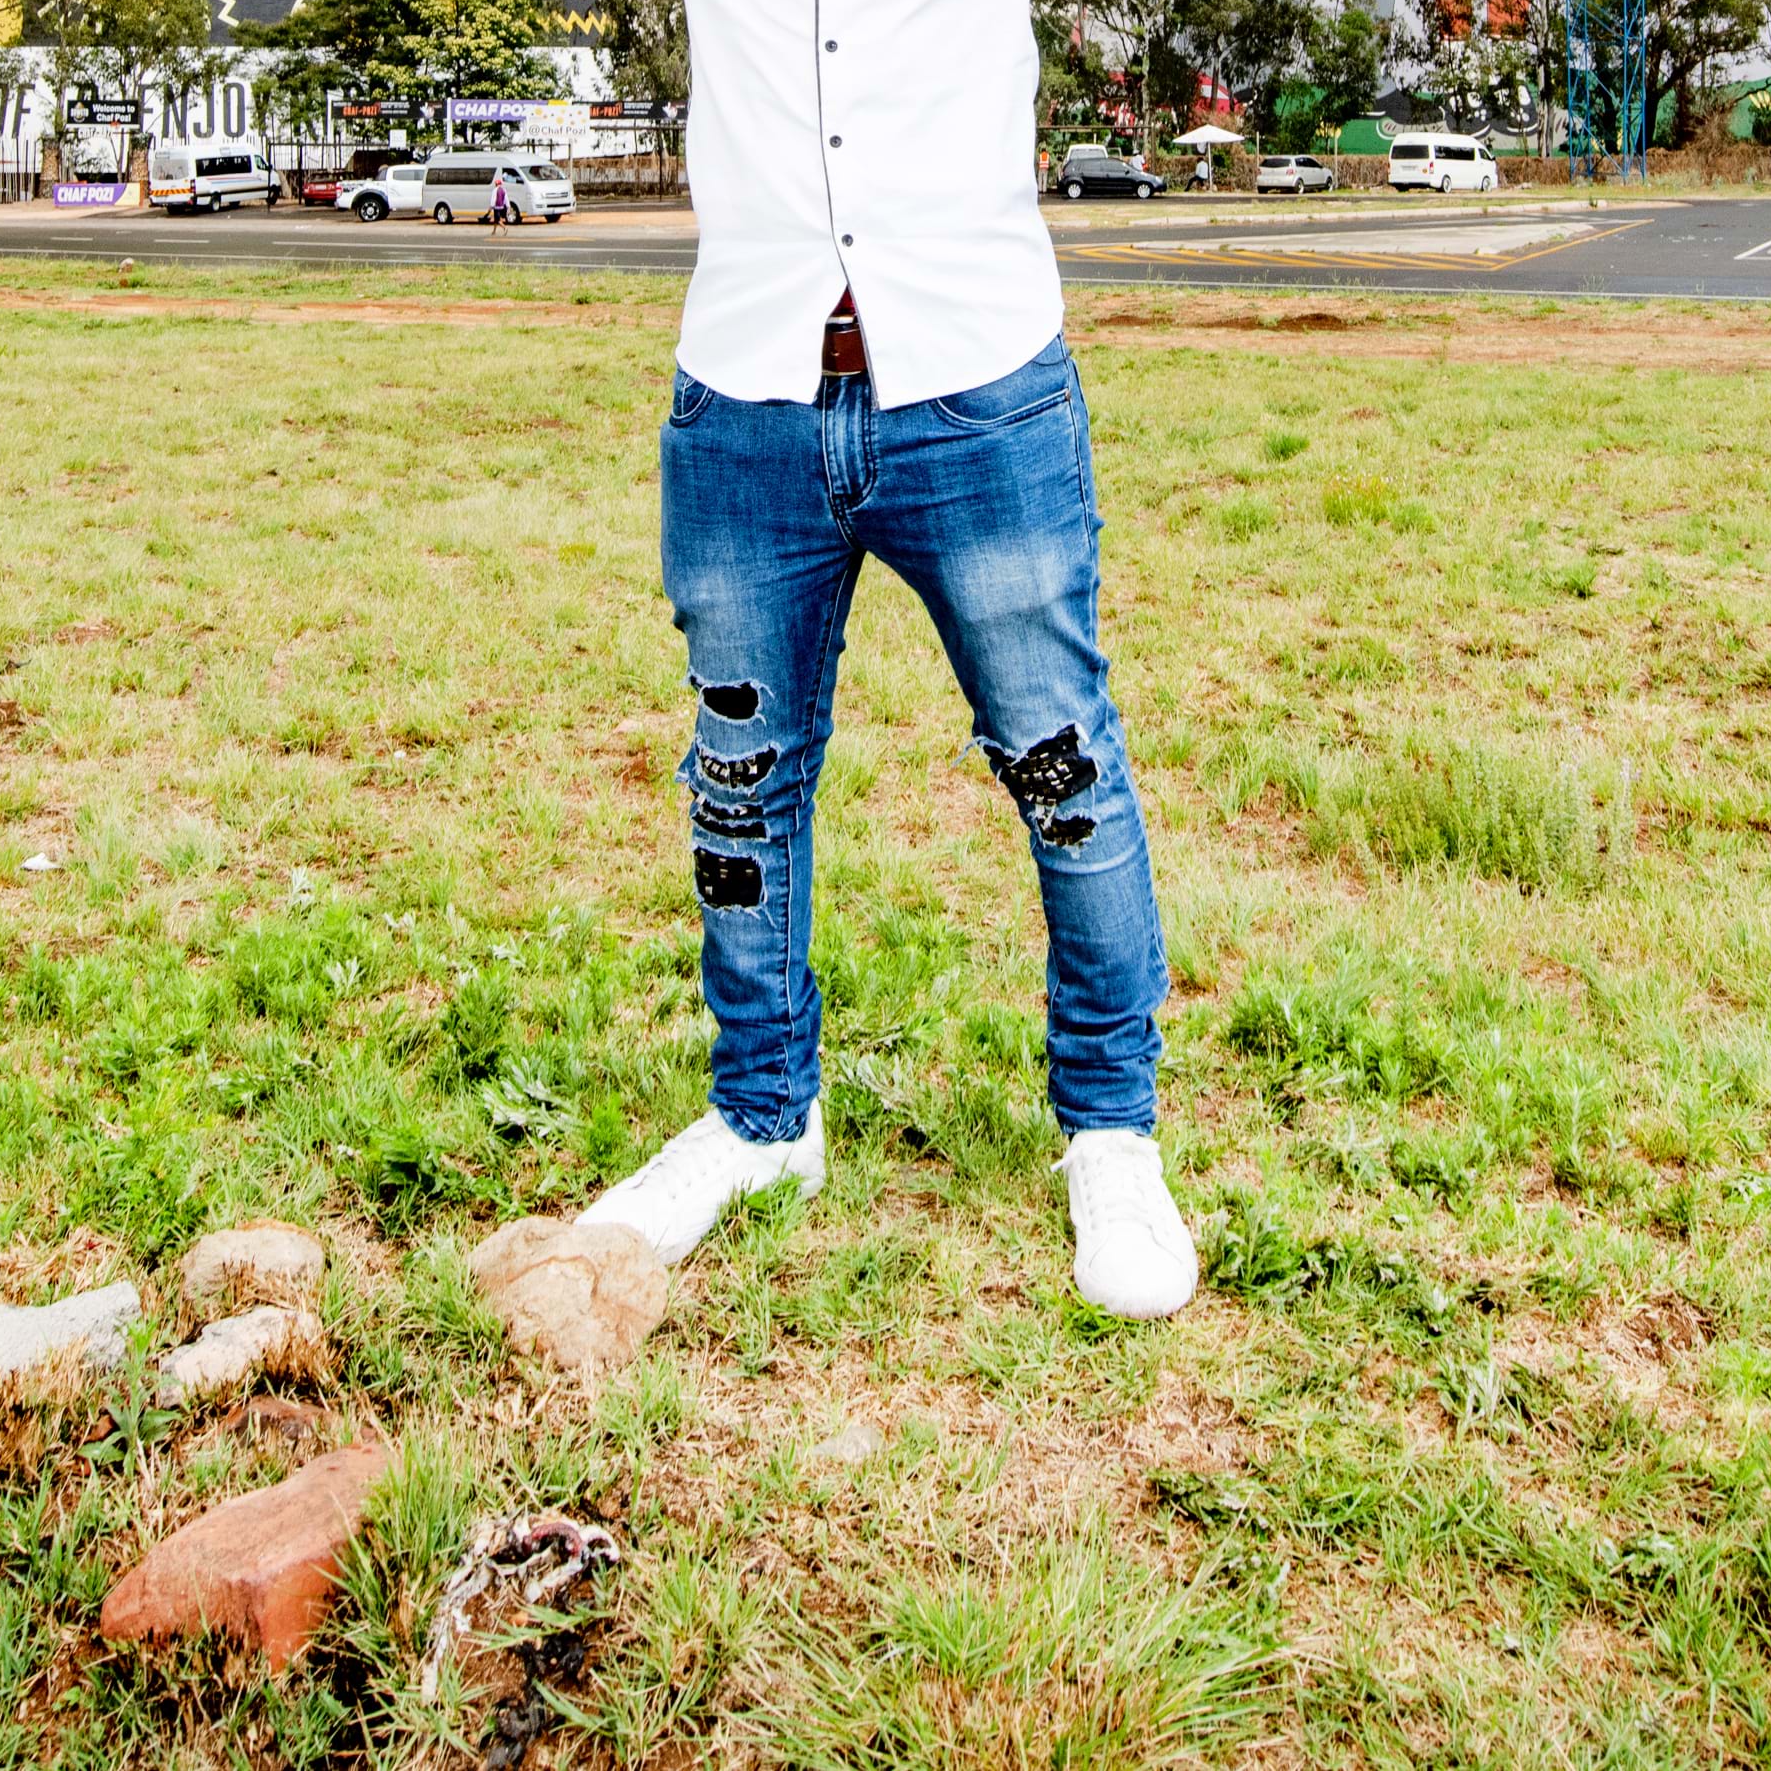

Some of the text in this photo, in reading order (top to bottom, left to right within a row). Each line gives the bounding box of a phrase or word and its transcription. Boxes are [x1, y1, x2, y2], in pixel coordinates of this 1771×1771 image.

[92, 103, 136, 113] Welcome to
[138, 82, 247, 139] ENJO
[454, 102, 528, 118] CHAF POZ
[96, 113, 114, 122] Chaf
[57, 186, 115, 203] CHAF POZI
